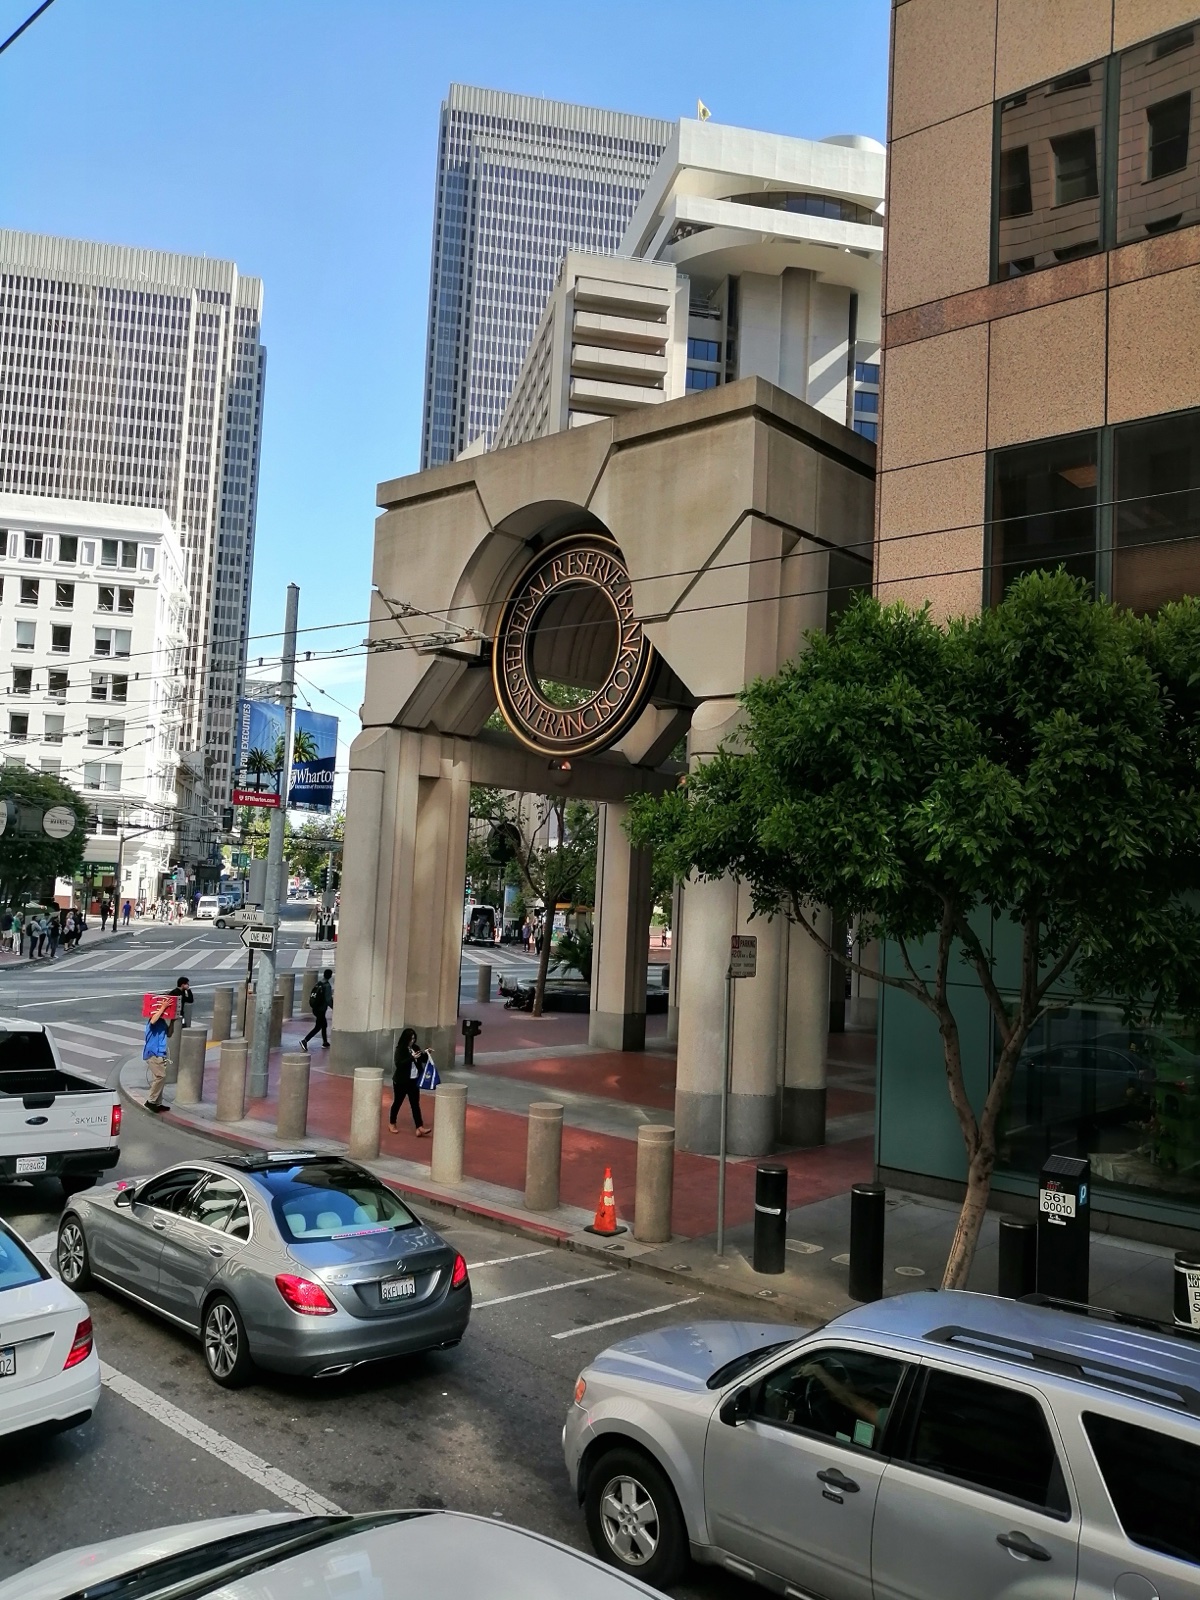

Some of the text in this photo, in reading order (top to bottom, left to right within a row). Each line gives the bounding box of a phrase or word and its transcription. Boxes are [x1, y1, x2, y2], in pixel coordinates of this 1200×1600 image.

[506, 552, 641, 673] FEDERAL RESERVE BANK
[511, 668, 633, 737] SAN FRANCISCO
[239, 703, 251, 786] MBA FOR EXECUTIVES
[241, 913, 258, 921] MAIN
[250, 932, 271, 943] ONE WAY
[74, 1115, 108, 1125] SKYLINE
[1044, 1191, 1066, 1204] 561
[1043, 1201, 1073, 1215] 00010
